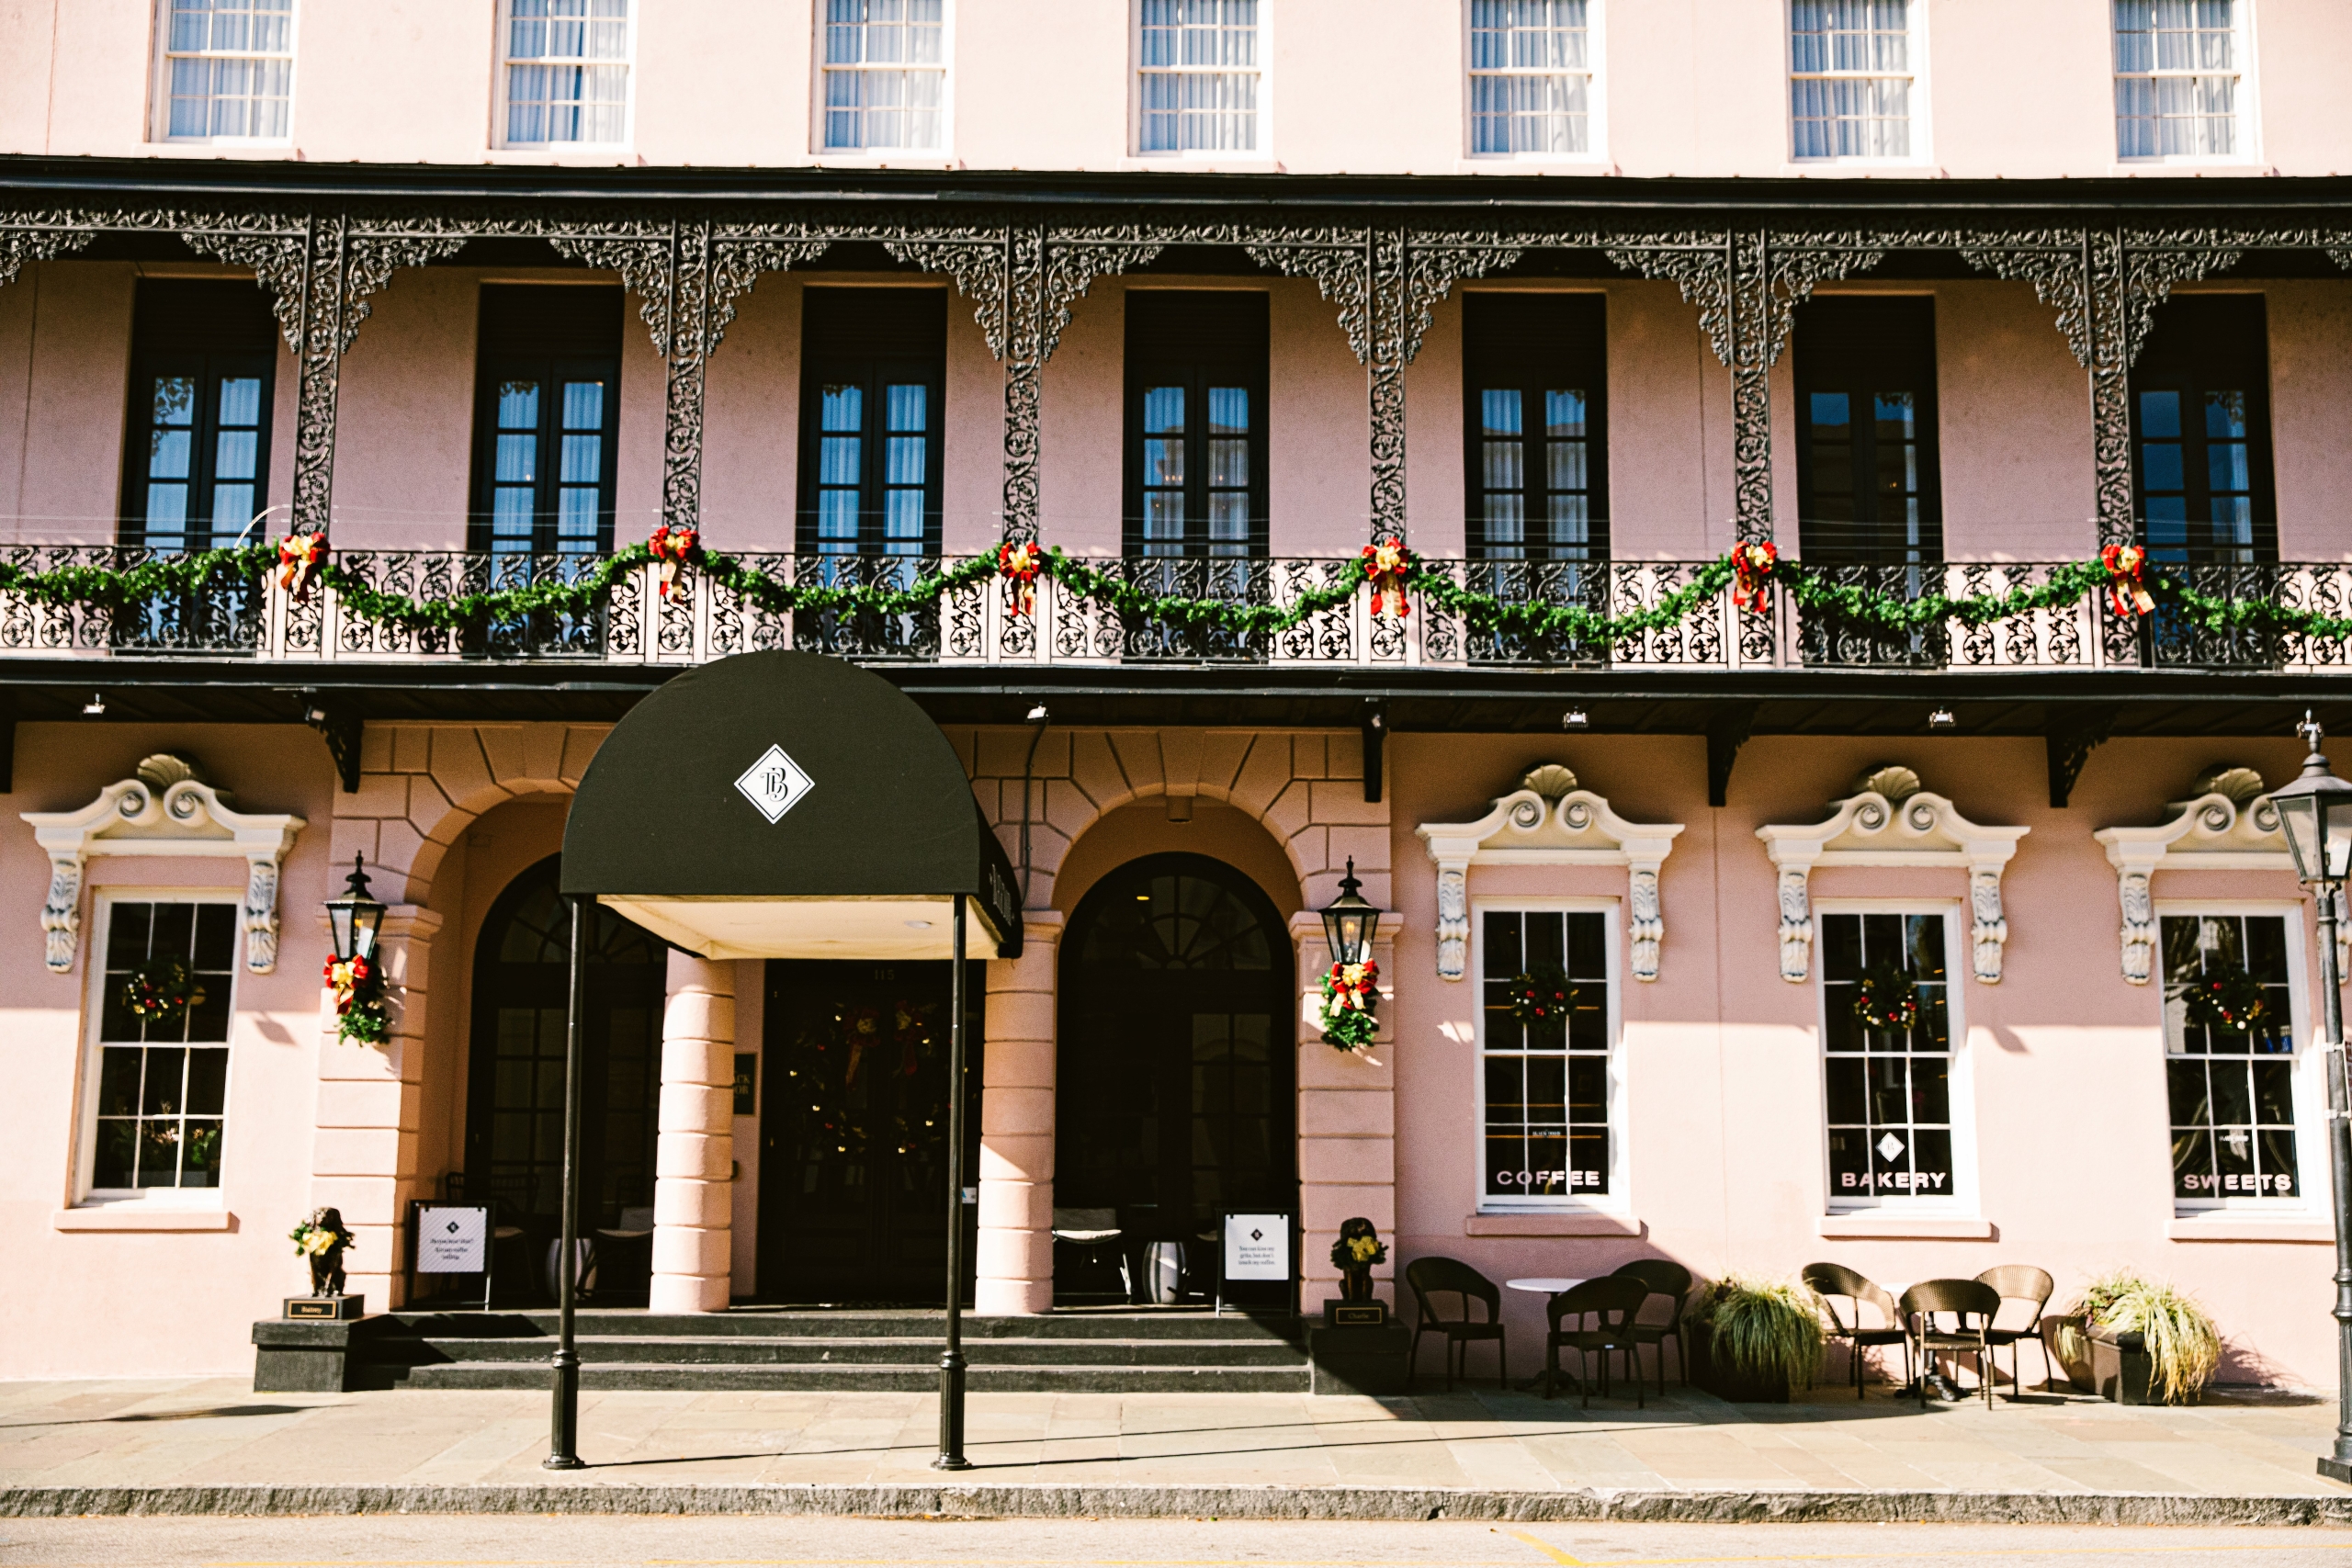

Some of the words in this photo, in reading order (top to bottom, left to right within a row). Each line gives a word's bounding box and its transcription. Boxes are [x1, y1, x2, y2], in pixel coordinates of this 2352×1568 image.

[874, 968, 895, 981] 115
[1497, 1170, 1600, 1186] COFFEE
[1841, 1172, 1946, 1189] BAKERY
[2184, 1173, 2292, 1190] SWEETS
